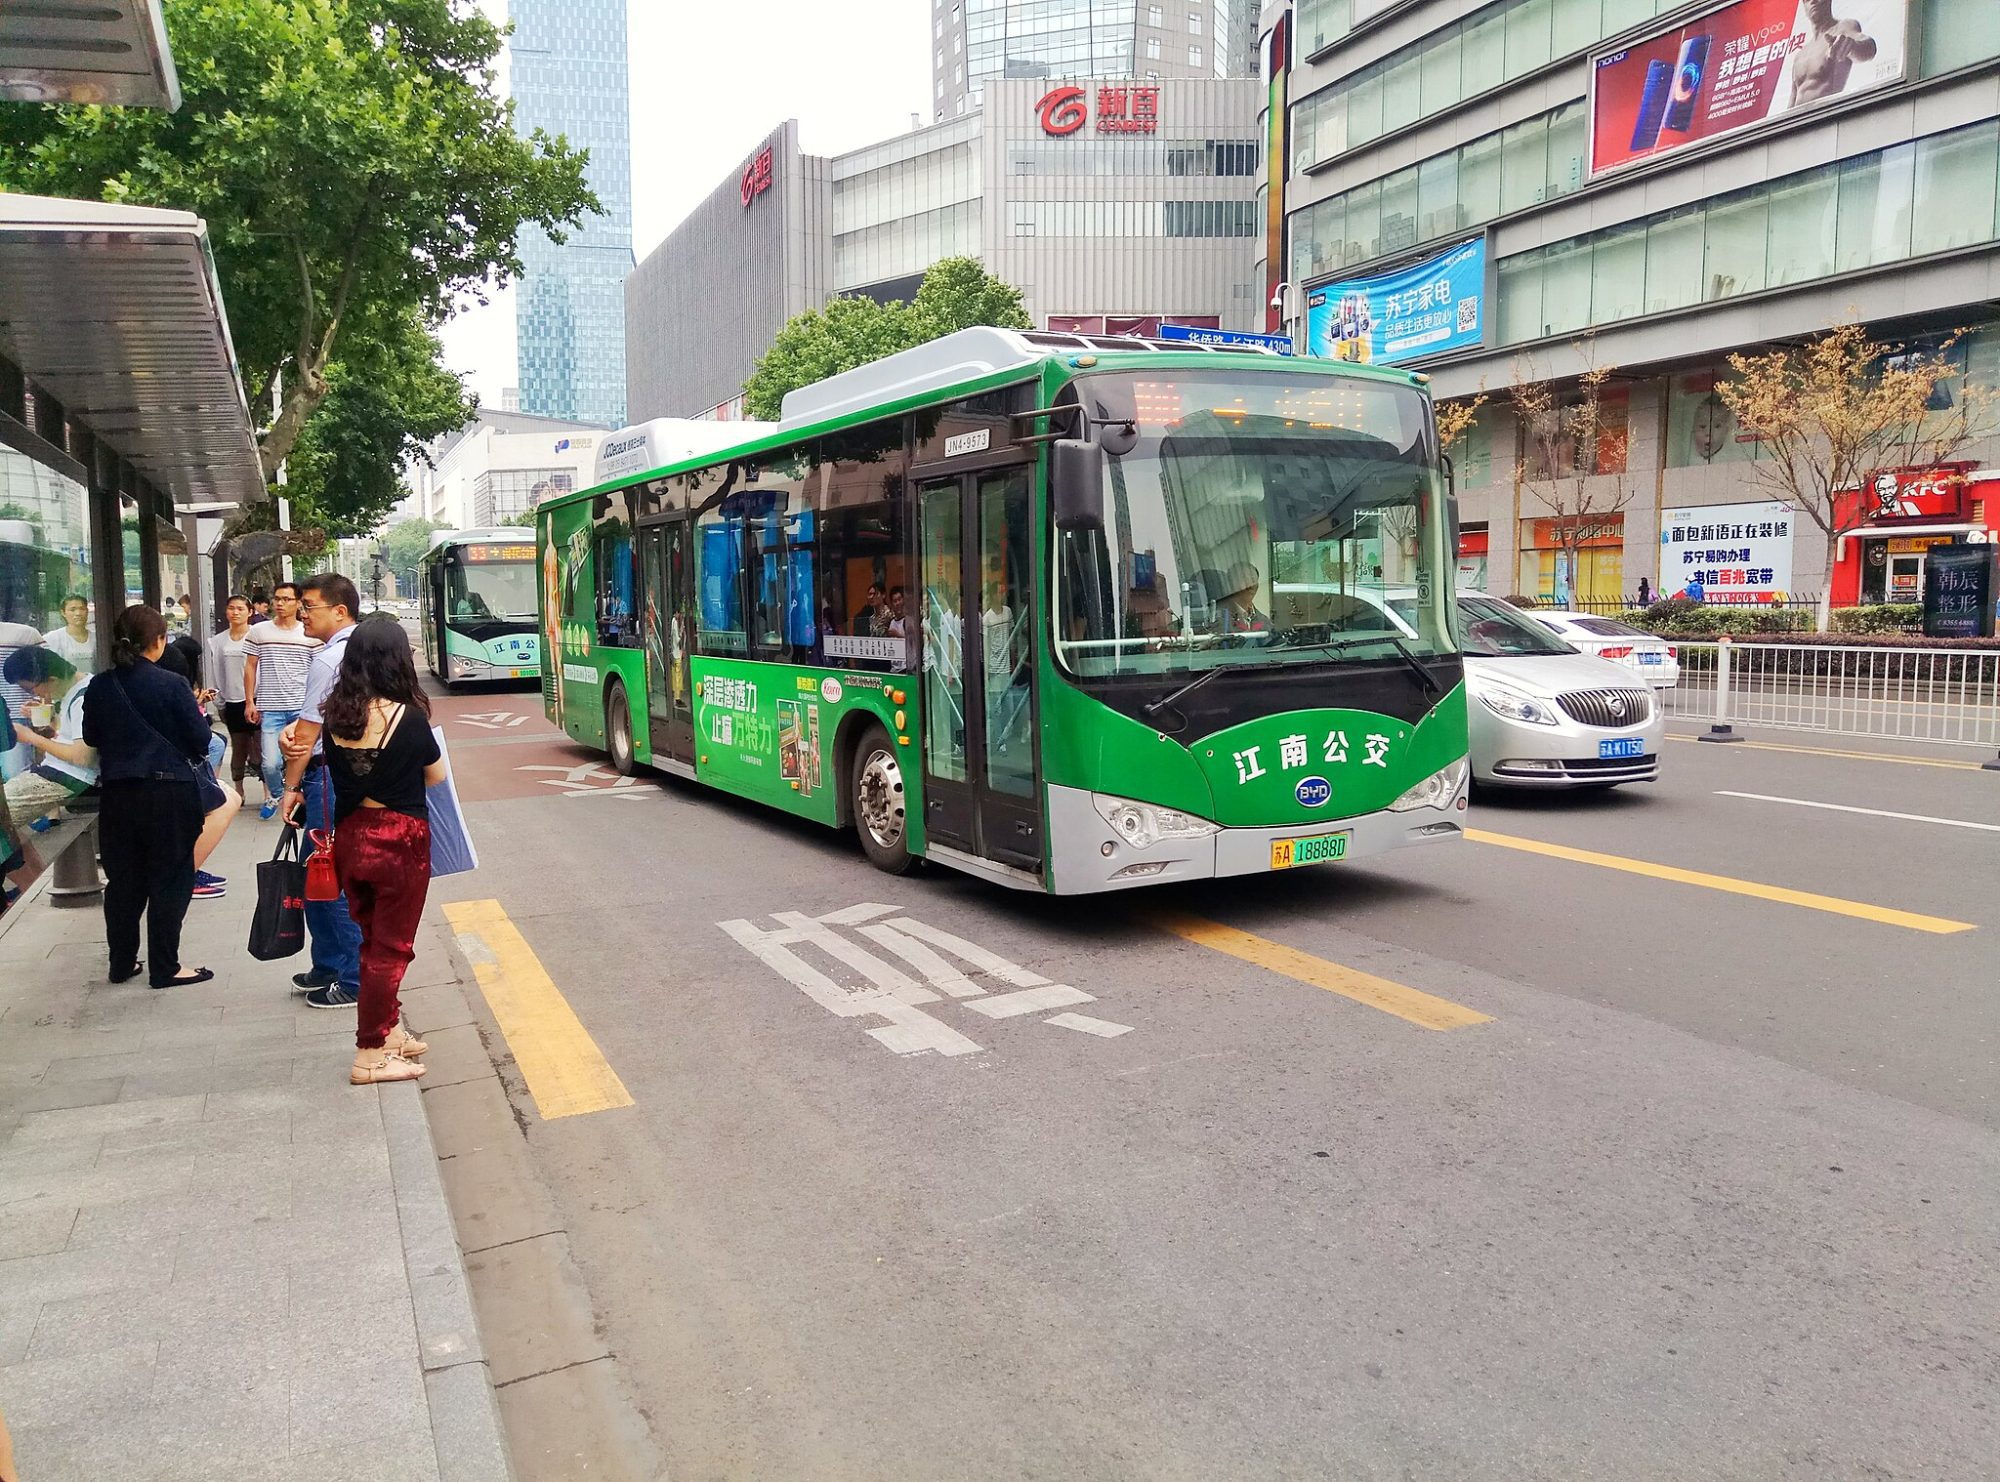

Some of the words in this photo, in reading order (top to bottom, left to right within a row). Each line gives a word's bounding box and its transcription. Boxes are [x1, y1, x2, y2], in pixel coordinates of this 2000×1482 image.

[1598, 51, 1627, 67] honor
[1718, 33, 1806, 80] 我想要的快
[1098, 87, 1160, 117] 新百
[1097, 121, 1158, 134] CENBEST
[1386, 279, 1452, 321] 苏宁家电
[1385, 308, 1452, 339] 品质生活更放心
[1901, 479, 1949, 498] KFC
[1672, 522, 1788, 543] 面包新语正在装修
[1683, 548, 1751, 564] 苏宁易购办理
[1693, 568, 1774, 585] 电信百兆宽带
[1938, 568, 1979, 590] 韩辰
[1936, 595, 1978, 613] 整形
[704, 675, 757, 714] 深层渗透力
[1232, 730, 1391, 784] 江南公交
[1300, 785, 1328, 800] BYD
[1297, 838, 1346, 862] 18888D
